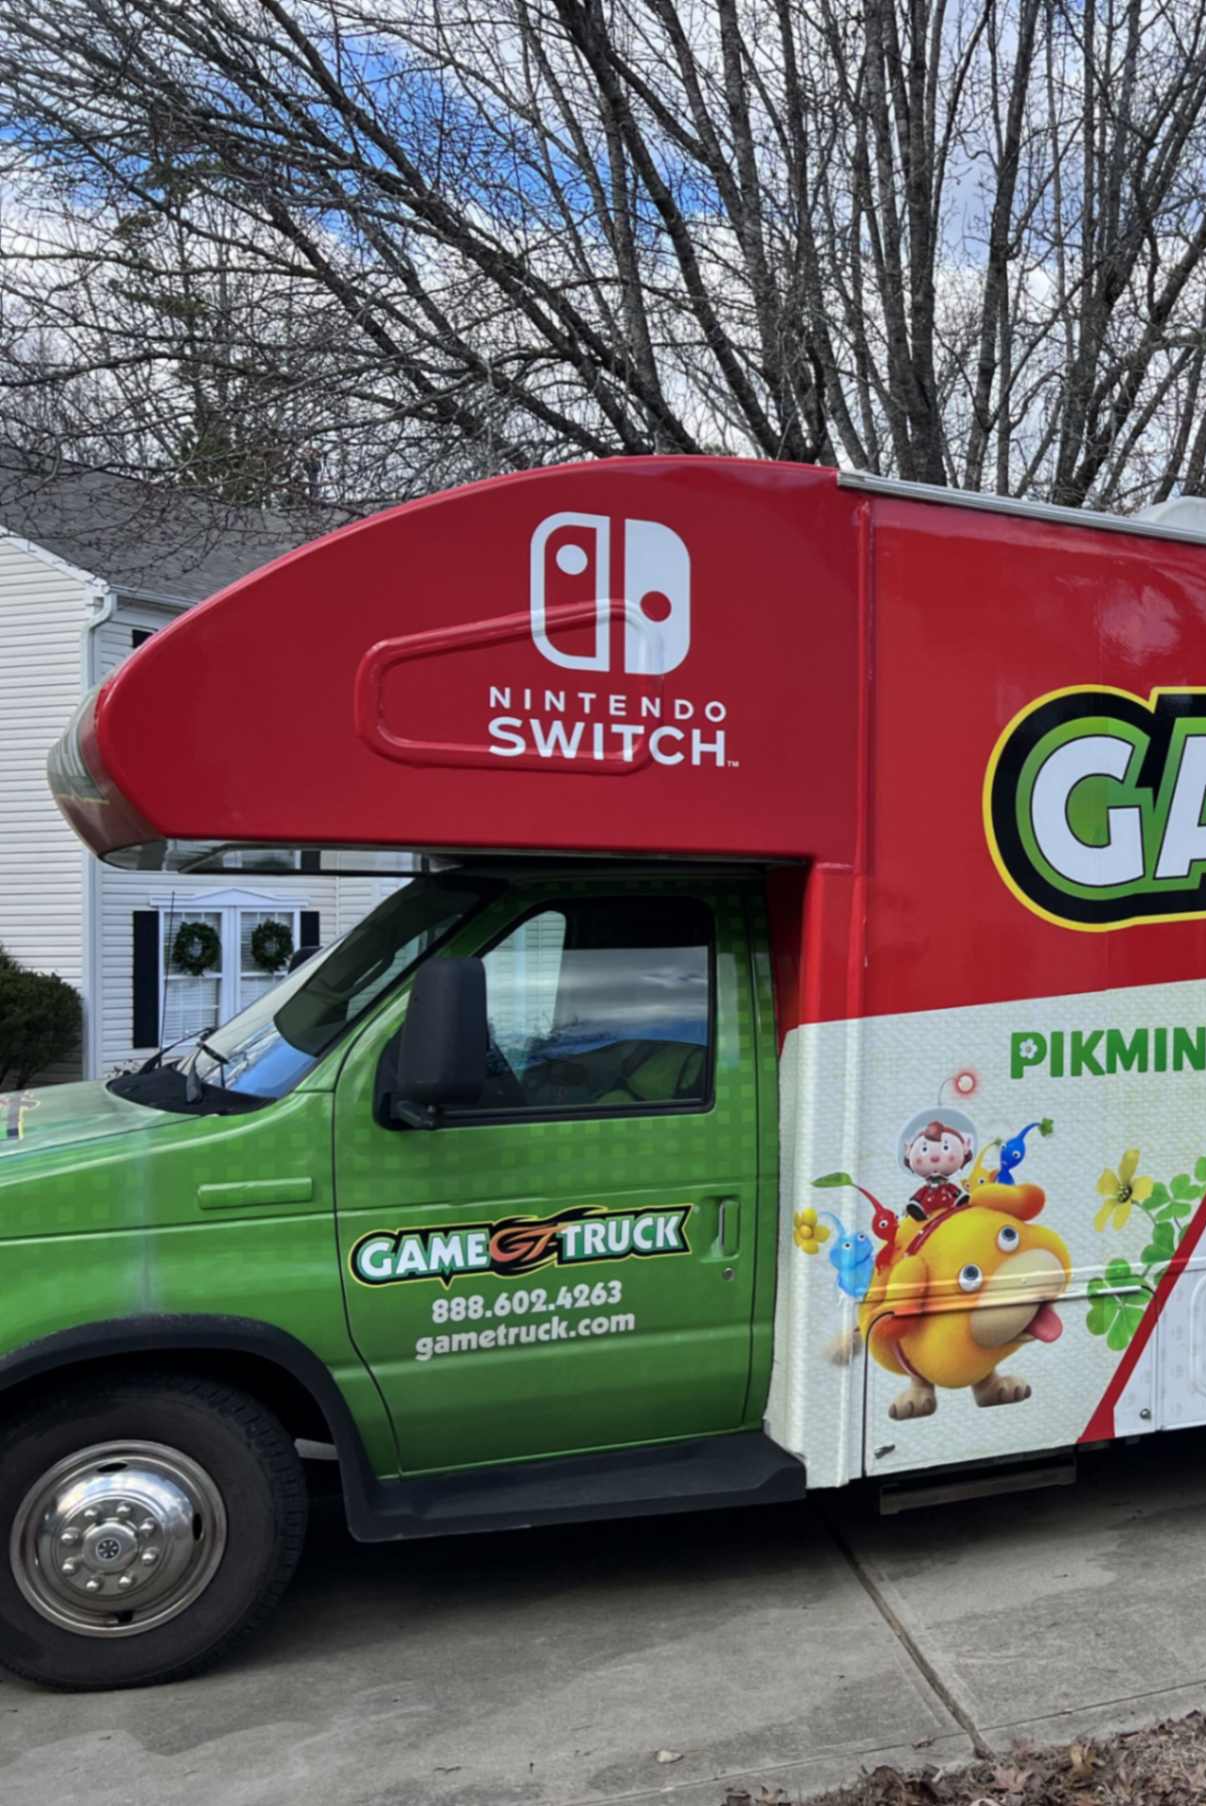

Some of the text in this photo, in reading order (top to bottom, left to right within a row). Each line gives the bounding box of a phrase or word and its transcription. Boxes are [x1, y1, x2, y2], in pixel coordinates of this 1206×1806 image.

[489, 686, 727, 722] NINTENDO
[488, 716, 726, 767] SWITCH
[1011, 1027, 1206, 1079] PIKMIN
[361, 1232, 488, 1277] GAME
[558, 1215, 682, 1257] TRUCK
[432, 1280, 622, 1323] 888.602.4263
[415, 1312, 635, 1361] gametruck.com
